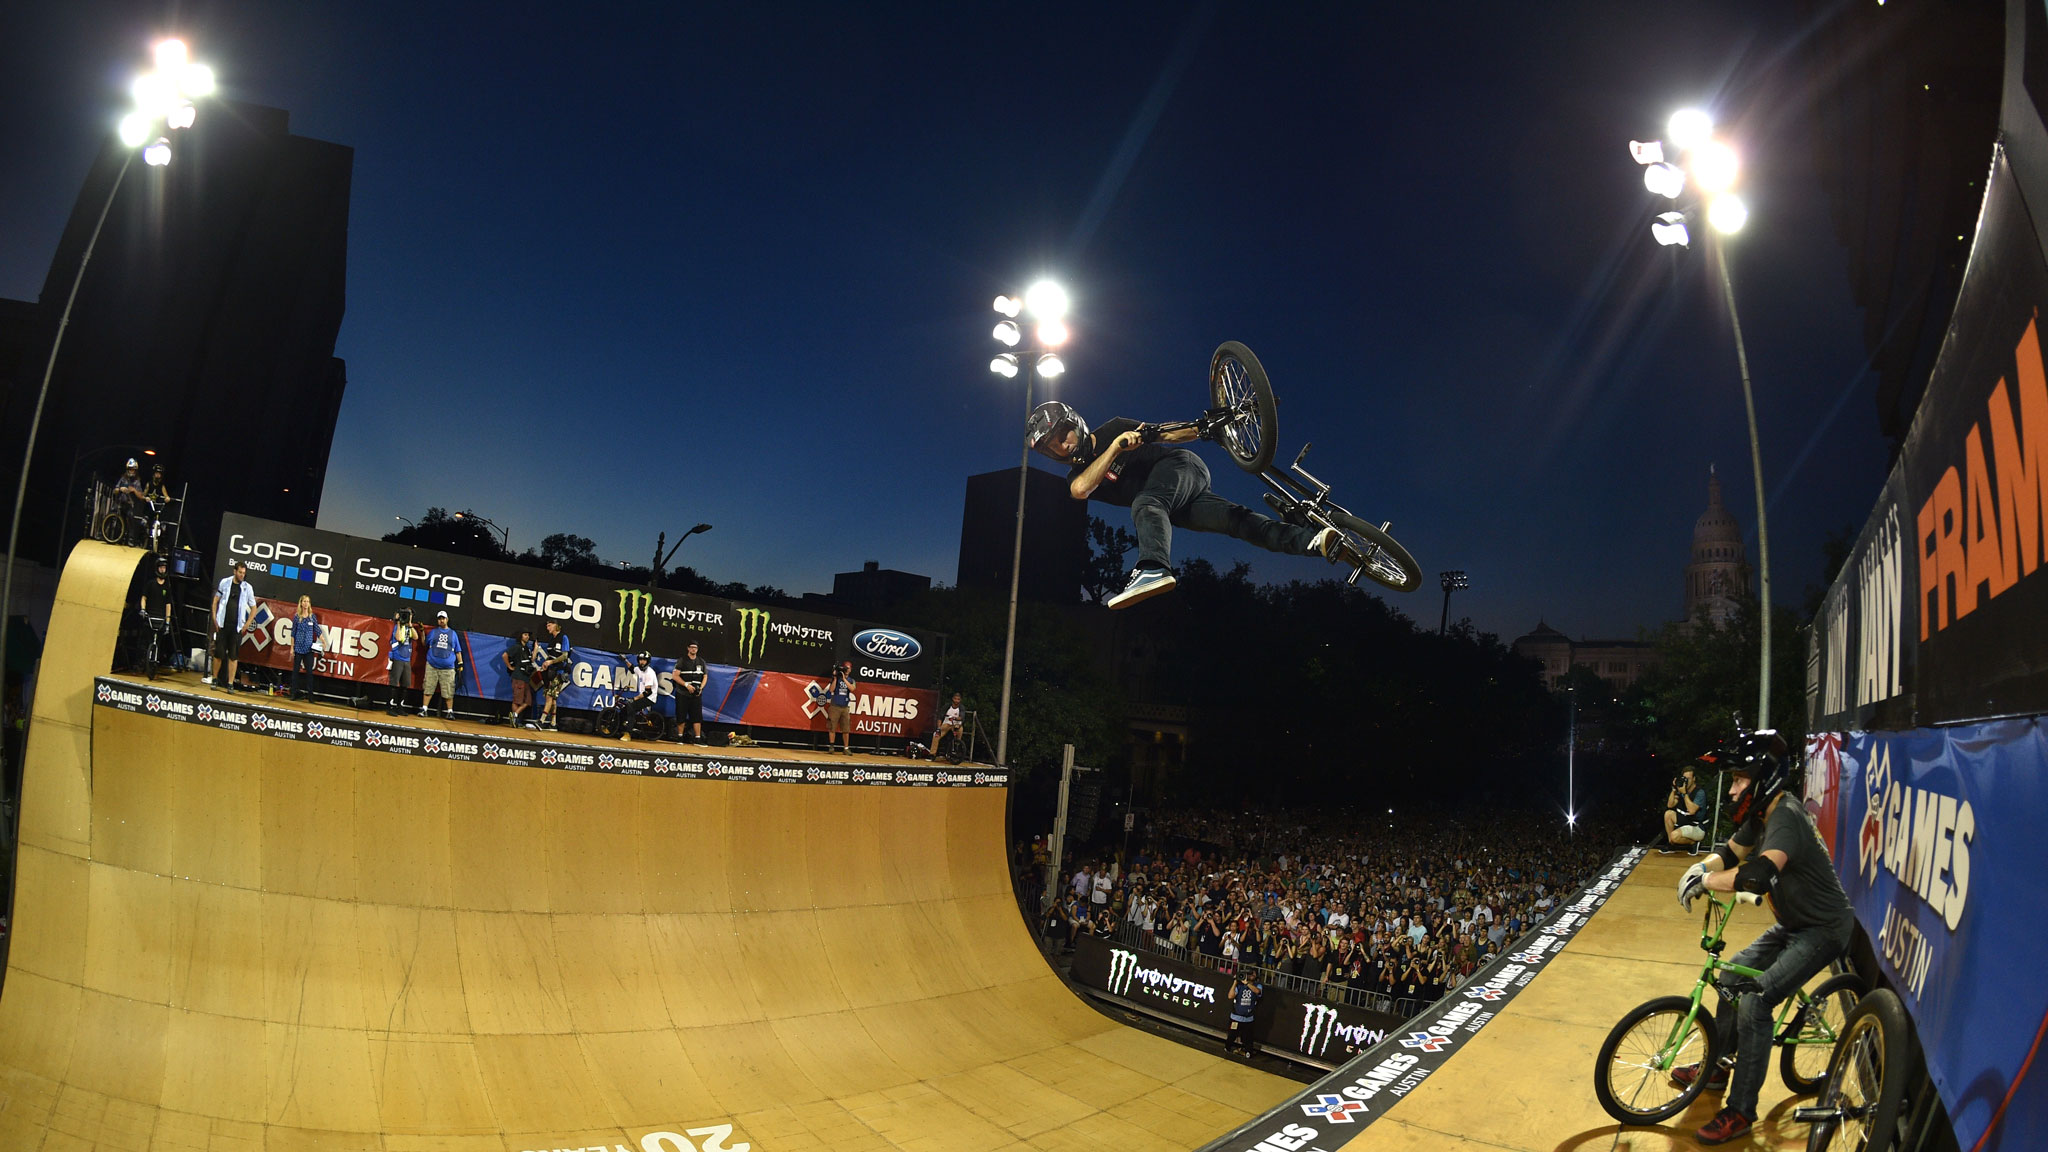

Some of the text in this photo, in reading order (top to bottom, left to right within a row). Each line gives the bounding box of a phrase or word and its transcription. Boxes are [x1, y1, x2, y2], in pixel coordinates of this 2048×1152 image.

[1917, 317, 2048, 643] FRAM
[229, 534, 333, 570] GoPro
[355, 558, 464, 592] GoPro
[355, 581, 365, 590] Be
[482, 583, 603, 624] GEICO
[662, 620, 713, 633] ENERGY
[273, 617, 380, 659] GMES
[779, 637, 824, 648] ENERGY
[866, 632, 909, 657] Ford
[572, 661, 675, 696] GAMS
[860, 666, 911, 682] Go Further
[110, 689, 143, 706] GAMES
[117, 703, 136, 712] AUSTIN
[159, 700, 194, 716] GAMES
[166, 712, 187, 722] AUSTIN
[212, 710, 248, 725] GAMES
[219, 722, 240, 731] AUSTIN
[266, 719, 304, 734] GAMES
[855, 719, 902, 734] AUSTIN
[274, 731, 296, 740] AUSTIN
[323, 726, 361, 741] GAMES
[330, 739, 353, 747] AUSTIN
[381, 734, 420, 748] GAMES
[389, 746, 412, 754] AUSTIN
[440, 742, 478, 755] GAMES
[499, 747, 537, 761] GAMES
[448, 753, 471, 761] AUSTIN
[506, 759, 529, 767] AUSTIN
[557, 753, 594, 765] GAMES
[613, 757, 650, 770] GAMES
[564, 764, 587, 772] AUSTIN
[621, 768, 643, 776] AUSTIN
[669, 762, 704, 773] GAMES
[721, 765, 754, 776] GAMES
[772, 768, 804, 778] GAMES
[819, 770, 850, 780] GAMES
[864, 772, 893, 781] GAMES
[907, 773, 934, 782] GAMES
[947, 774, 972, 783] GAMES
[984, 775, 1008, 783] GAMES
[1884, 780, 1976, 932] GAMES
[1878, 902, 1933, 1002] AUSTIN
[1484, 963, 1527, 989] GAMES
[1143, 986, 1200, 1009] ENERGY
[1427, 1001, 1484, 1036] GAMES
[1464, 1011, 1496, 1033] AUSTIN
[1342, 1052, 1420, 1101] GAMES
[1389, 1067, 1431, 1097] AUSTIN
